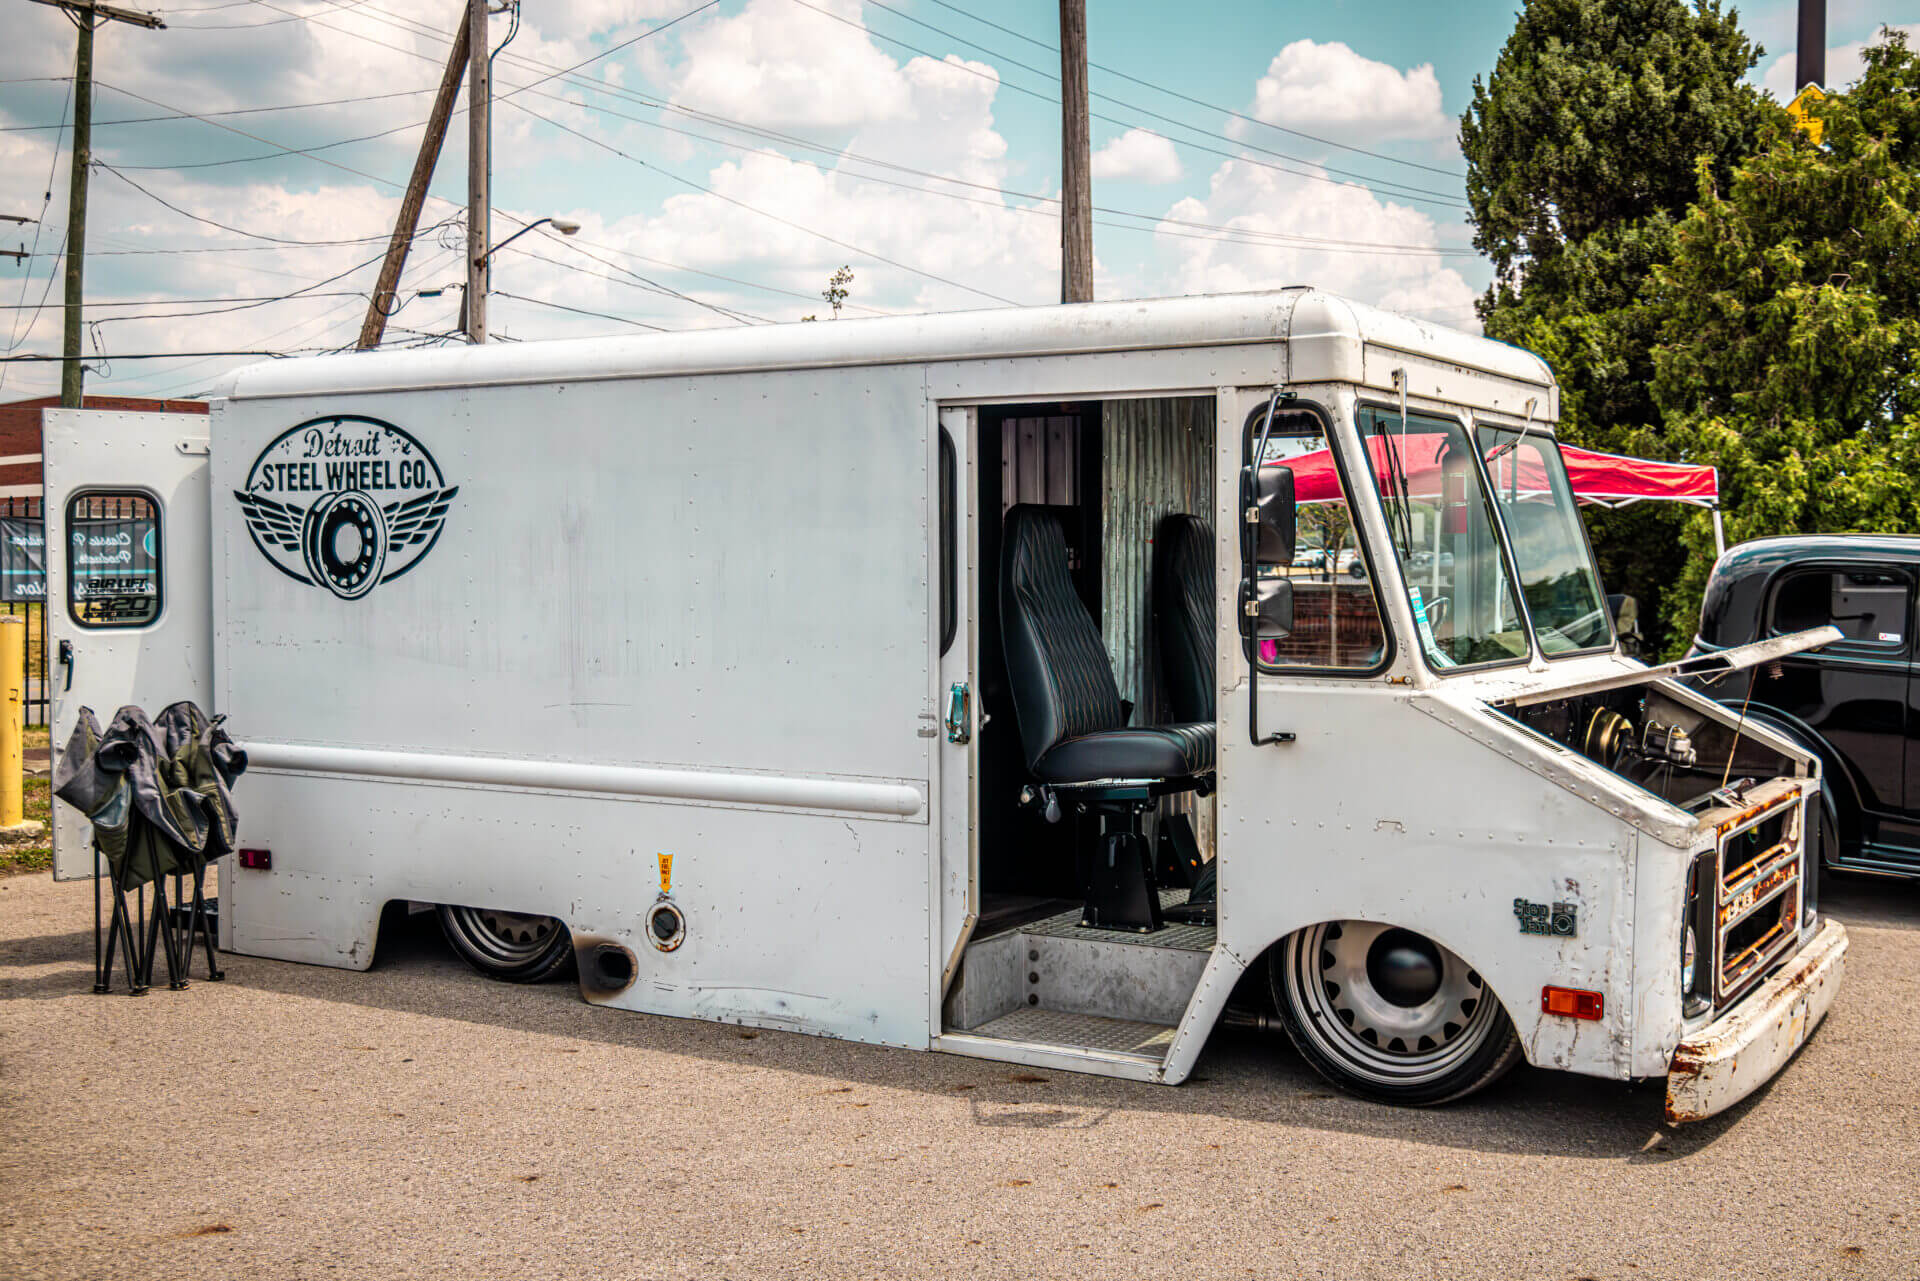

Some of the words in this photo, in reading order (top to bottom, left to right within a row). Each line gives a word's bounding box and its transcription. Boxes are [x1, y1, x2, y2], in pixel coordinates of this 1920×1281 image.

[303, 428, 382, 458] Detroit
[262, 462, 323, 492] STEEL
[326, 460, 397, 491] WHEEL
[399, 459, 432, 490] CO.
